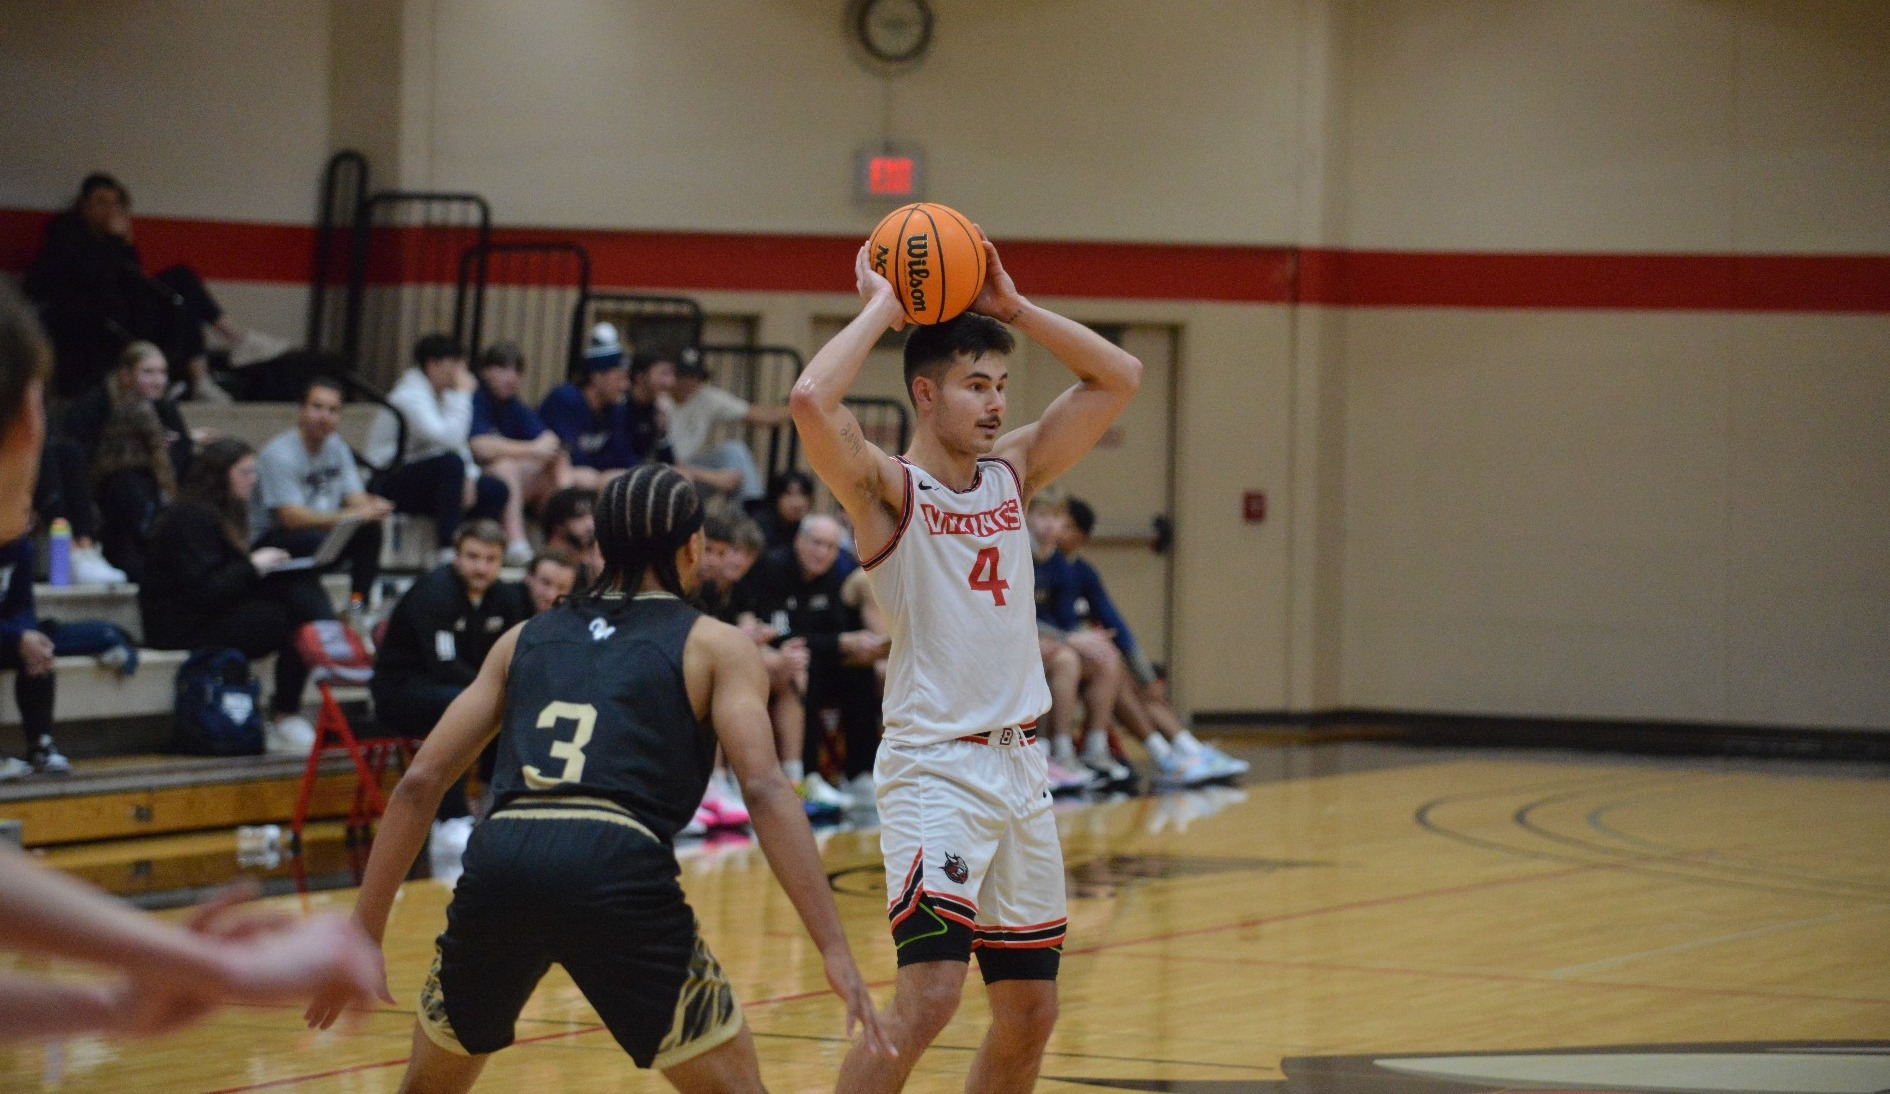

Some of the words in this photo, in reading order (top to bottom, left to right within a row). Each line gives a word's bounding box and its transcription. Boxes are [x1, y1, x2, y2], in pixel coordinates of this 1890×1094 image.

[907, 233, 930, 312] Wilson
[920, 499, 1021, 537] VIKINGS
[968, 547, 1010, 607] 4
[522, 701, 597, 790] 3
[1000, 728, 1013, 745] B
